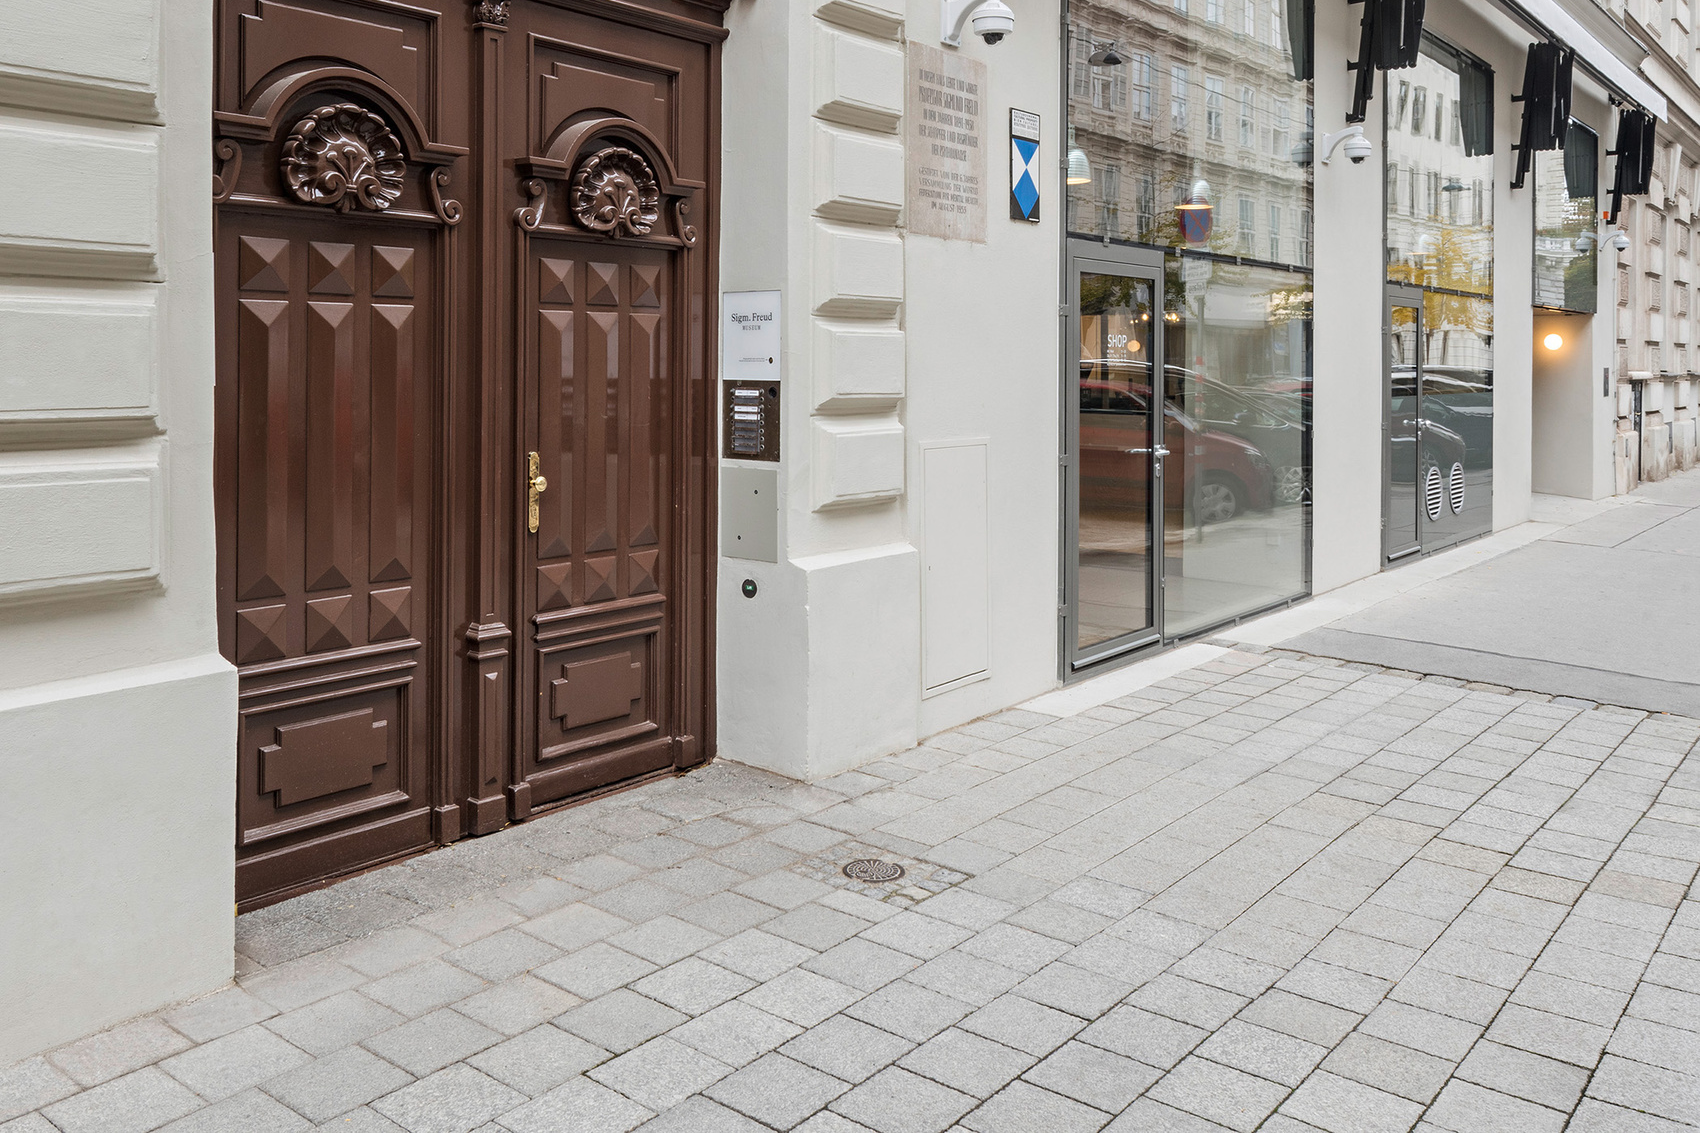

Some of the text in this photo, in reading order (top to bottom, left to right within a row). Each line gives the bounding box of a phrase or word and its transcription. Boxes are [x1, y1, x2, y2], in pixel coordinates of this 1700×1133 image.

[731, 312, 773, 324] Sigm. Freud
[1107, 334, 1128, 348] SHOP
